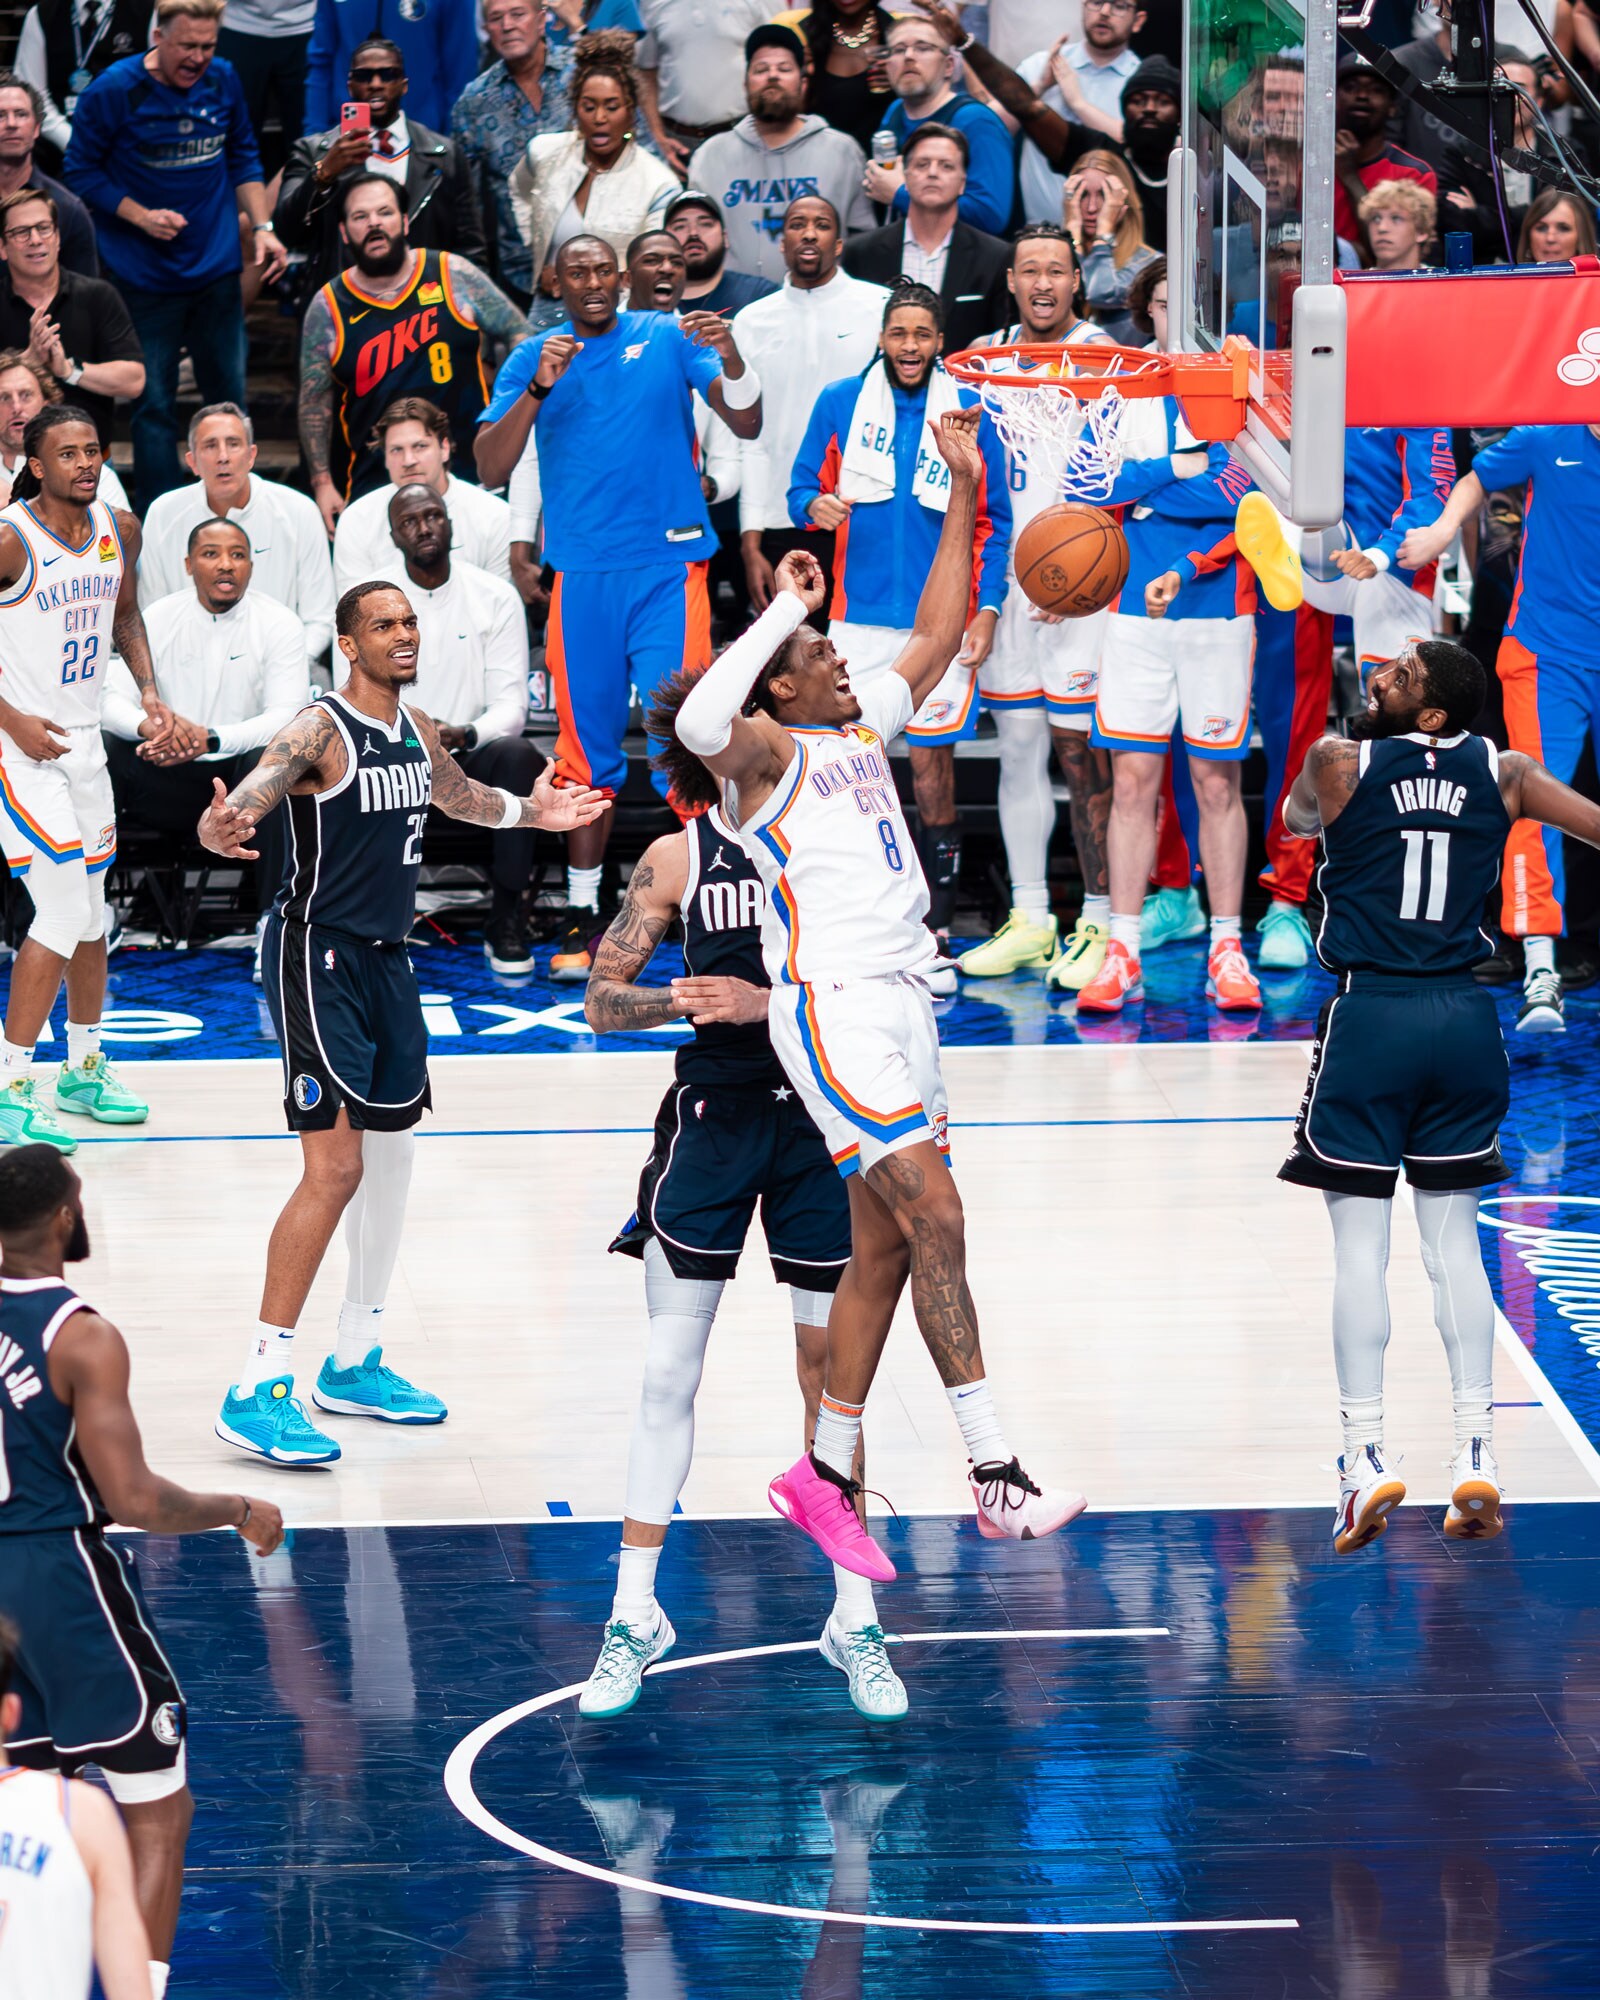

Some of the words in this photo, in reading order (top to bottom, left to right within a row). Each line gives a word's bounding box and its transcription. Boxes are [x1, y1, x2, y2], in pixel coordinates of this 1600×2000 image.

[723, 176, 819, 208] MAVS
[355, 306, 438, 397] OKC
[428, 341, 453, 384] 8
[34, 573, 121, 614] OKLAHOMA
[64, 603, 101, 633] CITY
[60, 632, 101, 688] 22
[358, 761, 432, 813] MAVS
[1390, 778, 1468, 817] IRVING
[876, 816, 905, 874] 8
[1399, 830, 1450, 921] 11
[4, 1364, 43, 1410] JR.
